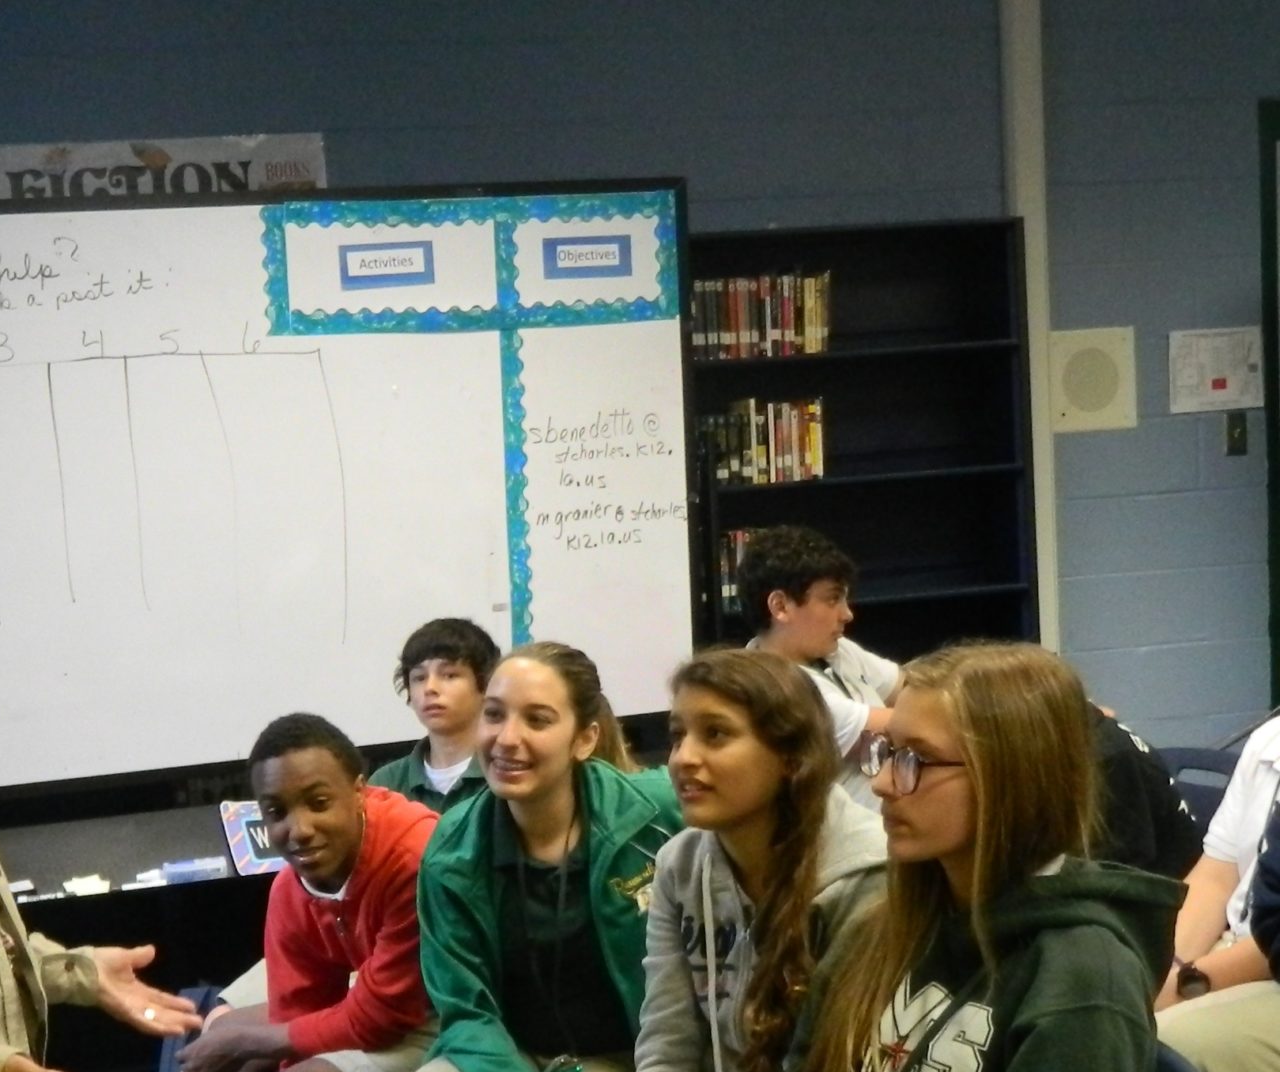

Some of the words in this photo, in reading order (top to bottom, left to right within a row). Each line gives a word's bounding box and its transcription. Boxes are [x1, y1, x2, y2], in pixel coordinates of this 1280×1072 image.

[7, 160, 252, 199] FICTION
[358, 256, 415, 271] Activities
[557, 250, 618, 263] Objectives
[26, 294, 43, 306] a
[81, 329, 104, 359] 4
[158, 328, 181, 355] 5
[243, 321, 262, 354] 6
